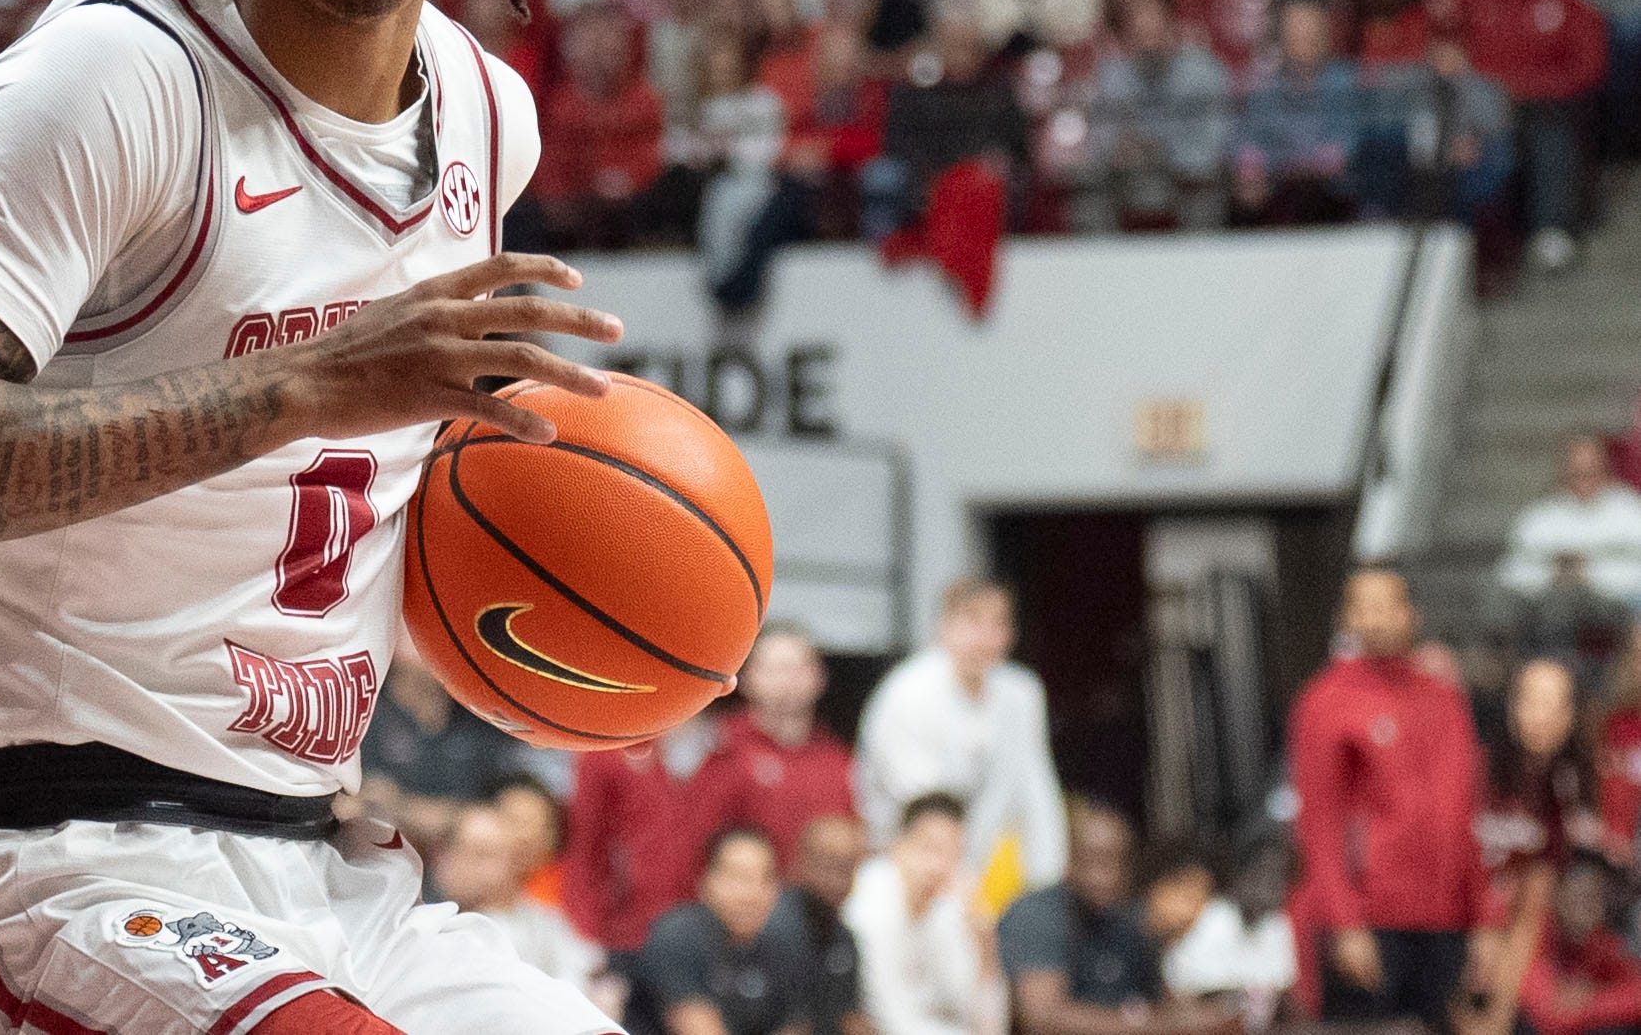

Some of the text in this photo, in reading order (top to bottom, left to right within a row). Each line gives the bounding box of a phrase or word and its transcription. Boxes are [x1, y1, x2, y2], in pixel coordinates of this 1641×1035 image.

[442, 162, 480, 235] SEC
[270, 448, 379, 618] 0
[223, 638, 377, 765] TIDE
